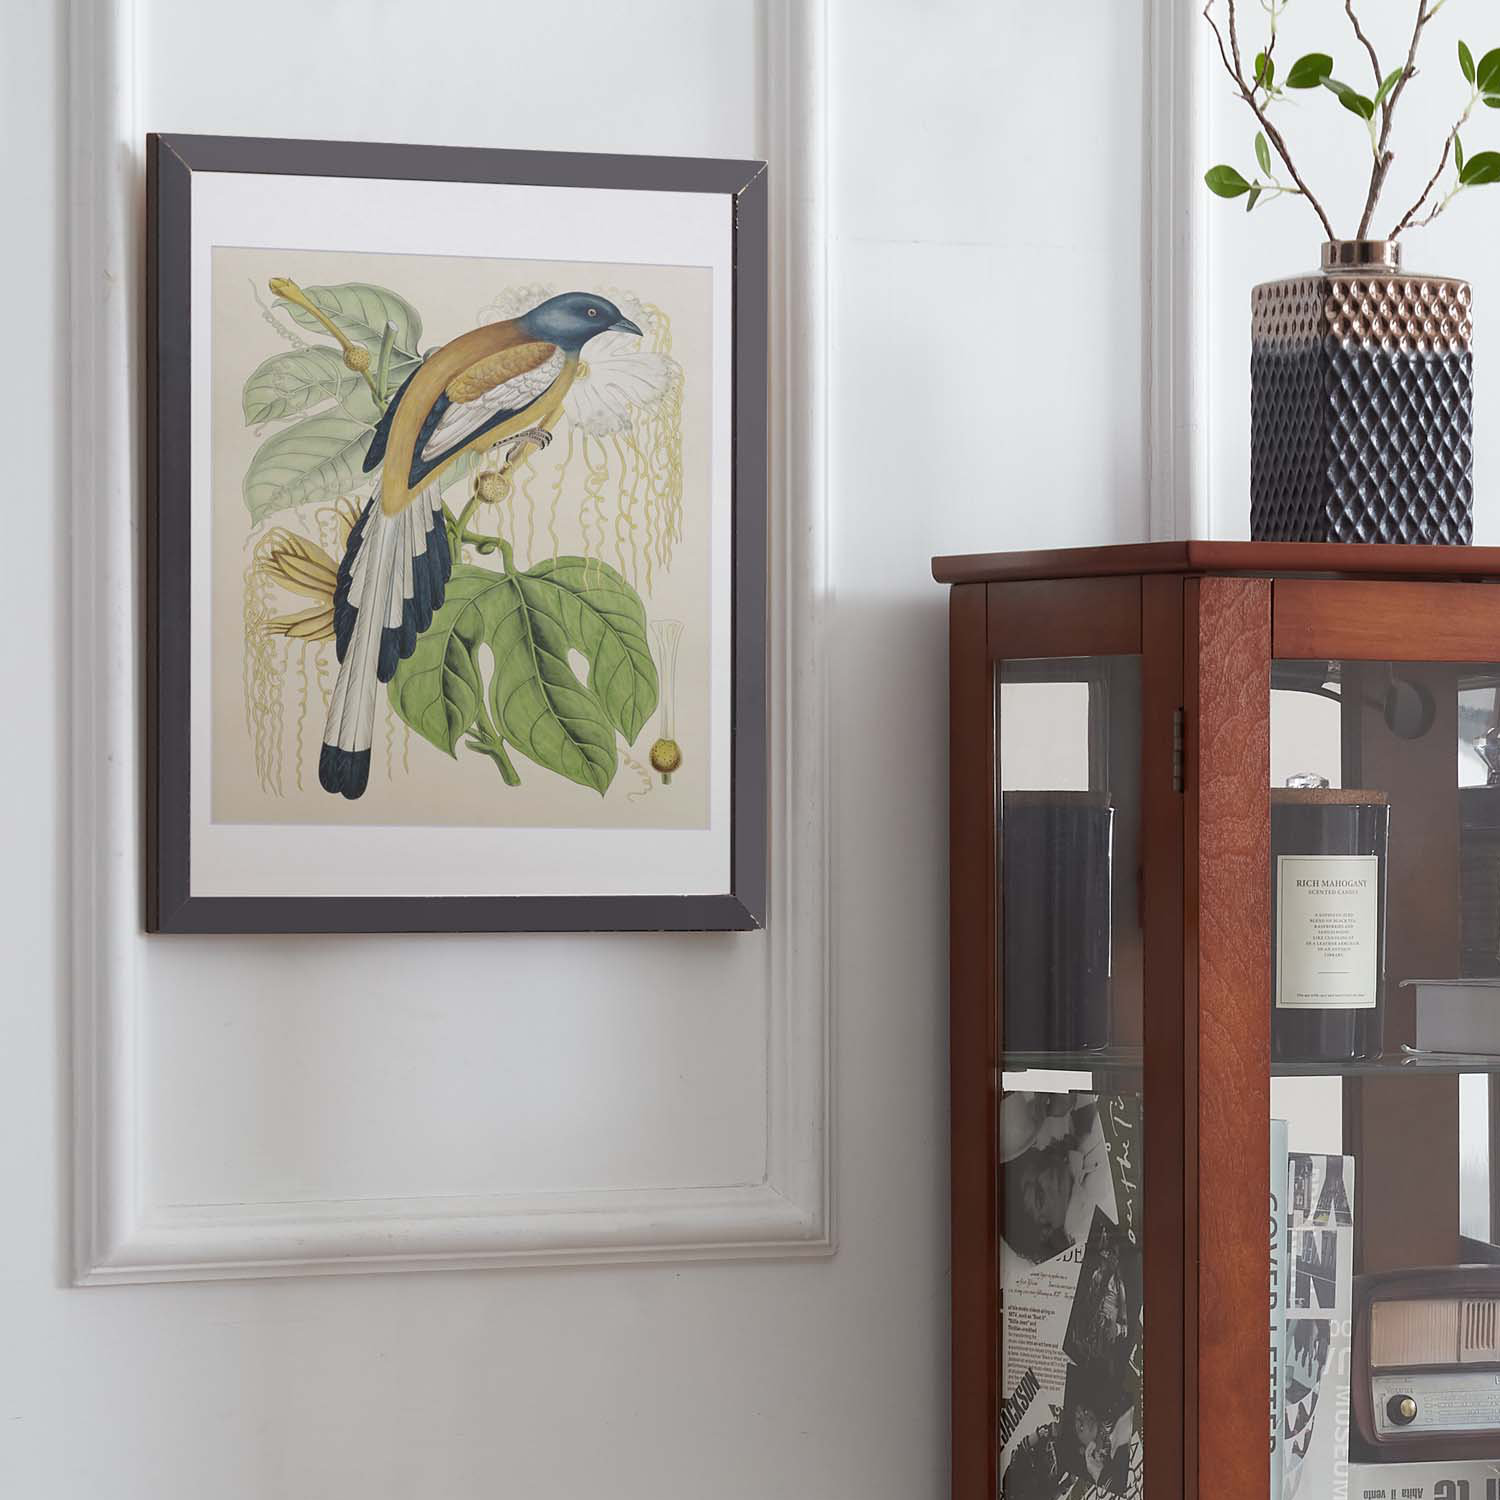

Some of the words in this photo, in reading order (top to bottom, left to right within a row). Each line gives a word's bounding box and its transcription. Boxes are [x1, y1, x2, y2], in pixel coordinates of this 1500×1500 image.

[1296, 879, 1319, 888] RICH
[1321, 879, 1367, 888] MAHOGANY
[1000, 1367, 1041, 1445] JACKSON
[1331, 1384, 1350, 1500] MUSEUM
[1363, 1489, 1387, 1500] vento
[1401, 1487, 1424, 1500] Abita
